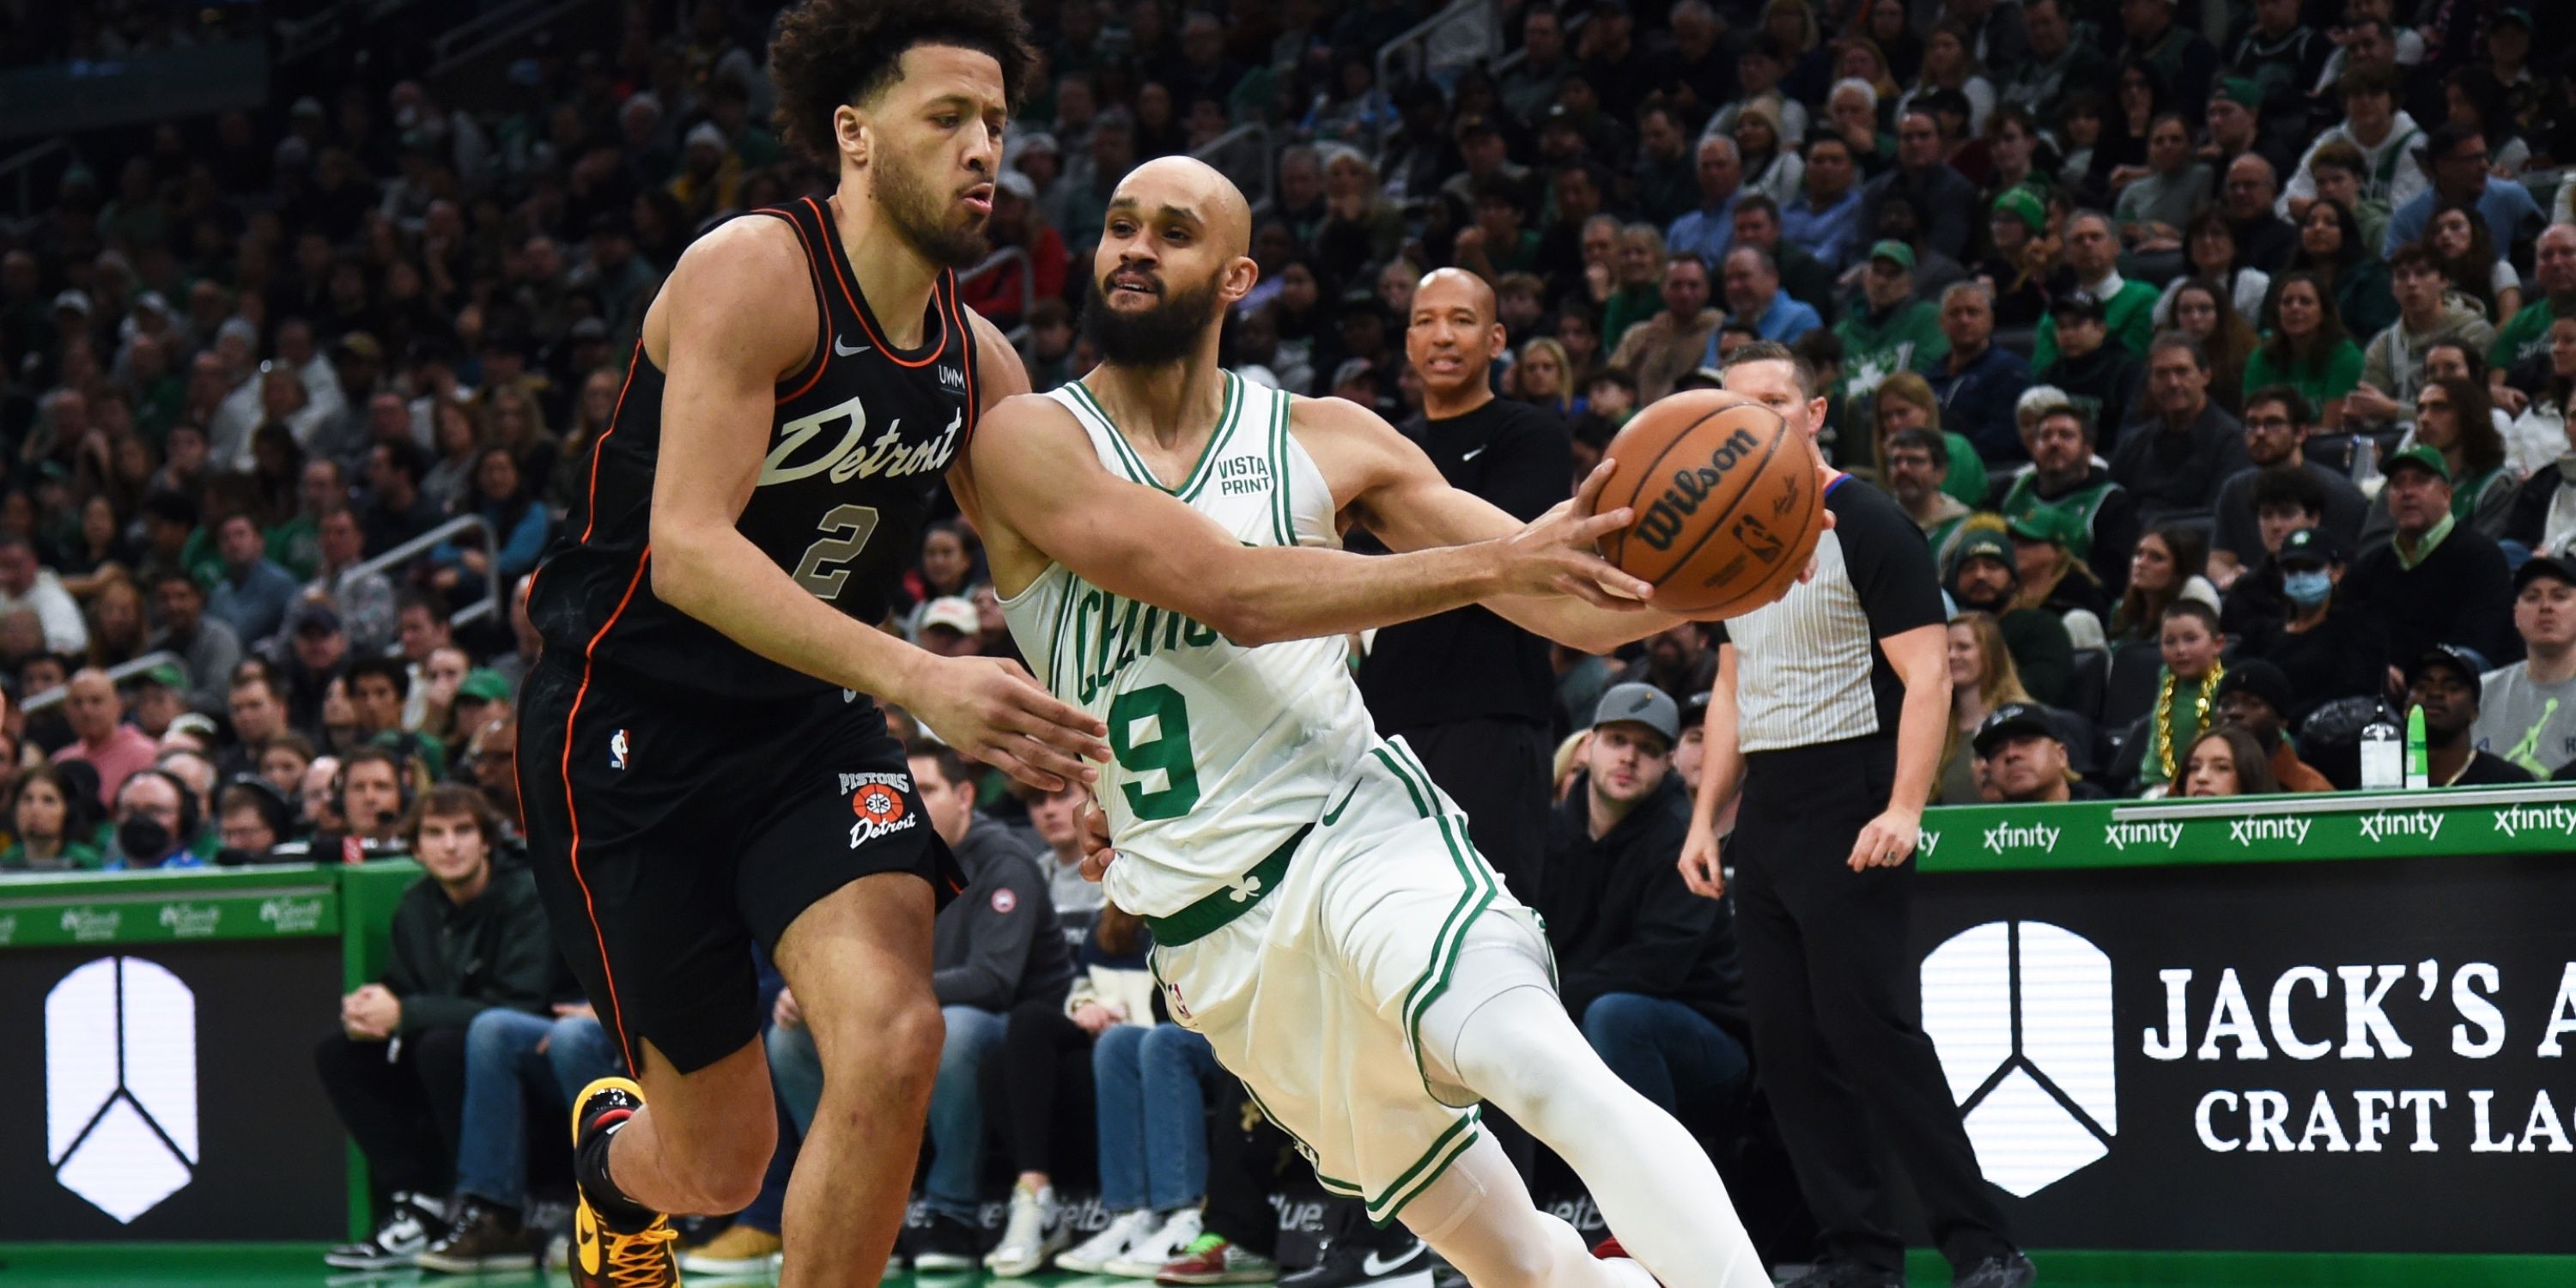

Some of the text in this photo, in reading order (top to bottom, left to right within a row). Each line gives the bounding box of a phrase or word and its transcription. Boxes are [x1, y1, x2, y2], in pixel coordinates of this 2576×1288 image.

[939, 364, 965, 389] UWM
[756, 396, 963, 484] Detroit
[1218, 456, 1268, 479] VISTA
[1222, 477, 1269, 495] PRINT
[1635, 428, 1759, 551] Wilson
[792, 504, 879, 599] 2
[1107, 683, 1201, 821] 9
[839, 773, 910, 796] PISTONS
[849, 812, 916, 849] Detroit
[2105, 821, 2184, 851] xfinity
[2230, 815, 2312, 847] xfinity
[2360, 810, 2445, 842] xfinity
[2494, 804, 2576, 837] xfinity
[1984, 822, 2061, 854] xfinity
[2142, 958, 2506, 1060] JACK'S
[2195, 1090, 2576, 1152] CRAFT LA
